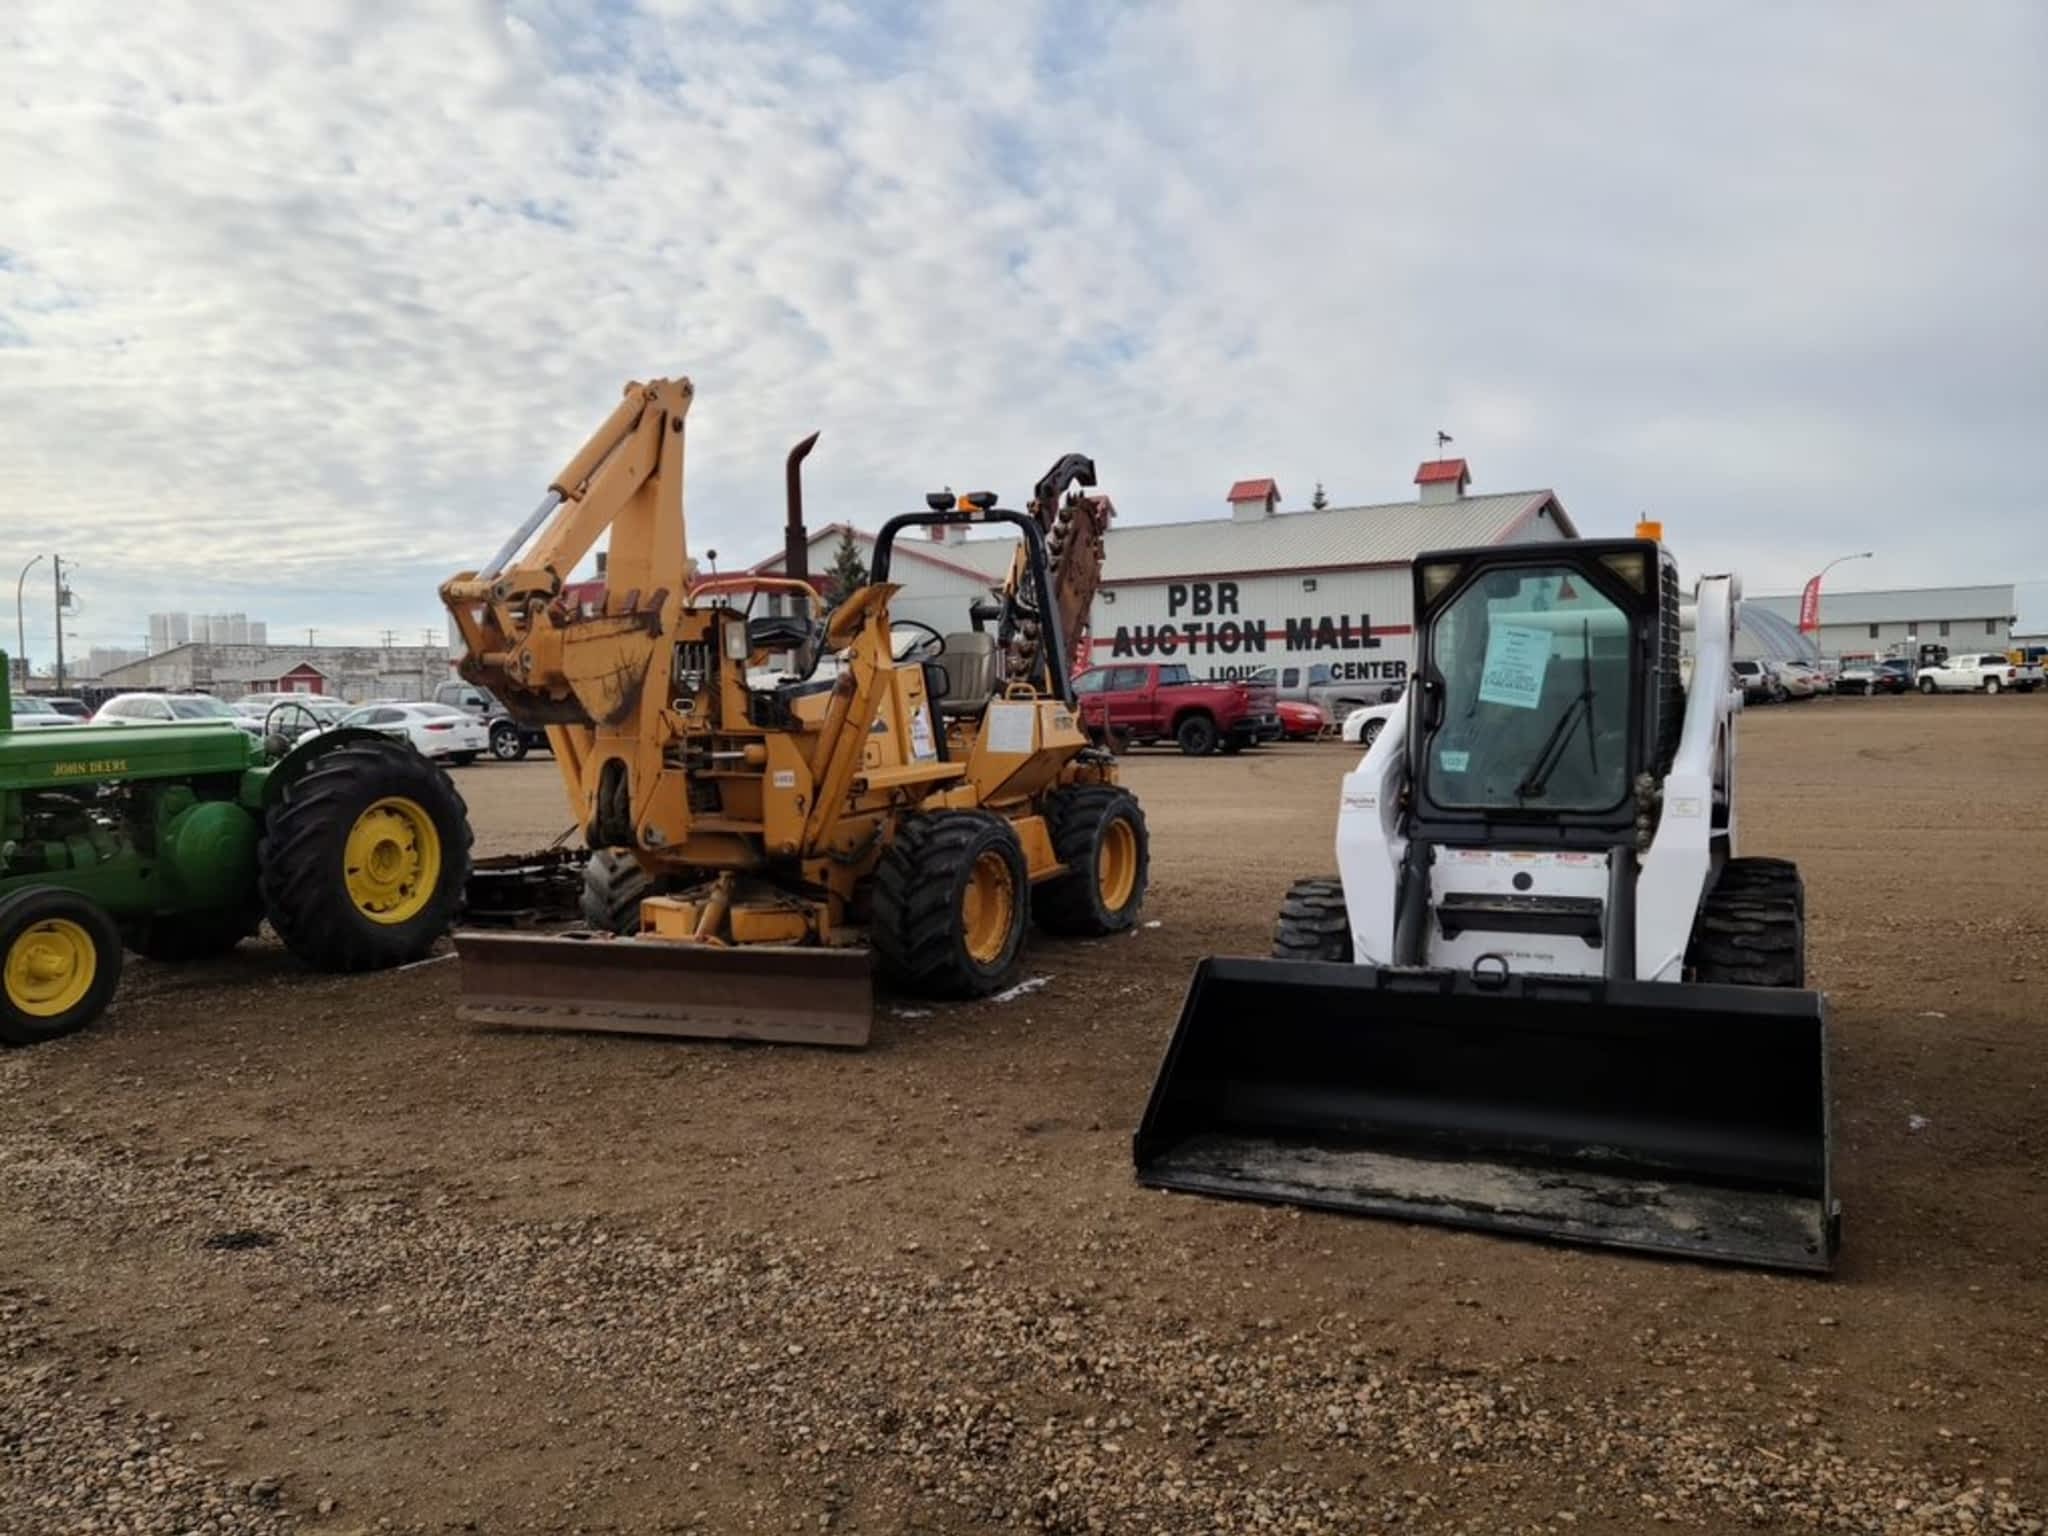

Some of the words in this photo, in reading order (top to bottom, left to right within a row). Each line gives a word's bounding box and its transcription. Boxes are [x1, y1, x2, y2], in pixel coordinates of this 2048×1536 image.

[1168, 582, 1239, 617] PBR
[1112, 619, 1266, 657] AUCTION
[1286, 613, 1382, 651] MALL
[1330, 661, 1407, 680] CENTER
